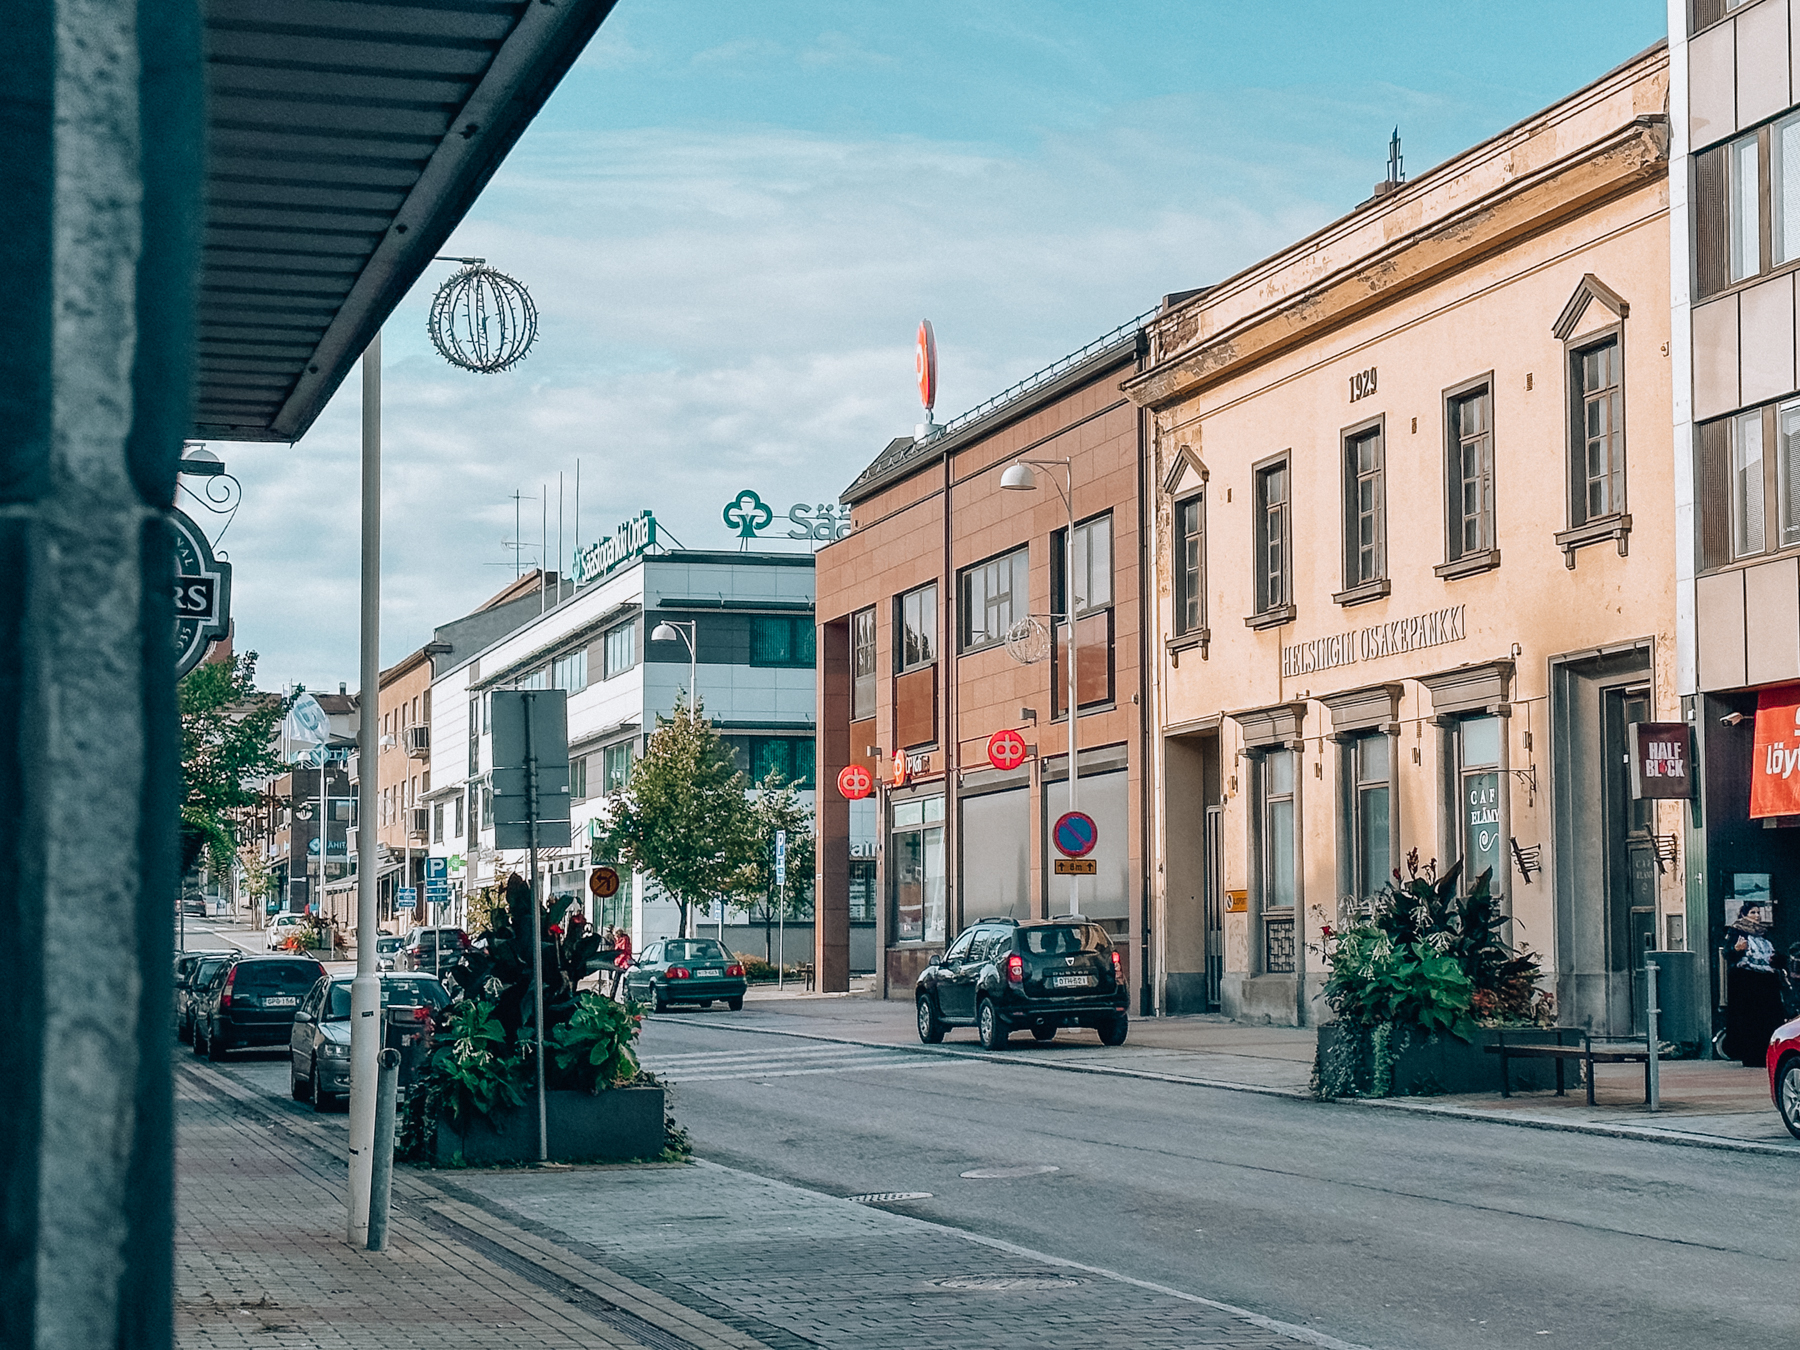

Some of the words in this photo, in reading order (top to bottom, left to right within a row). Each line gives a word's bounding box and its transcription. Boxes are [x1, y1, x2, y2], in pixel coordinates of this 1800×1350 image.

[1349, 366, 1378, 403] 1929
[176, 537, 194, 567] VAL
[175, 626, 192, 655] 935
[1282, 630, 1357, 679] HELSINGIN
[1360, 604, 1467, 662] OSAKEPANKKI
[1648, 742, 1682, 760] HALF
[430, 859, 444, 877] P
